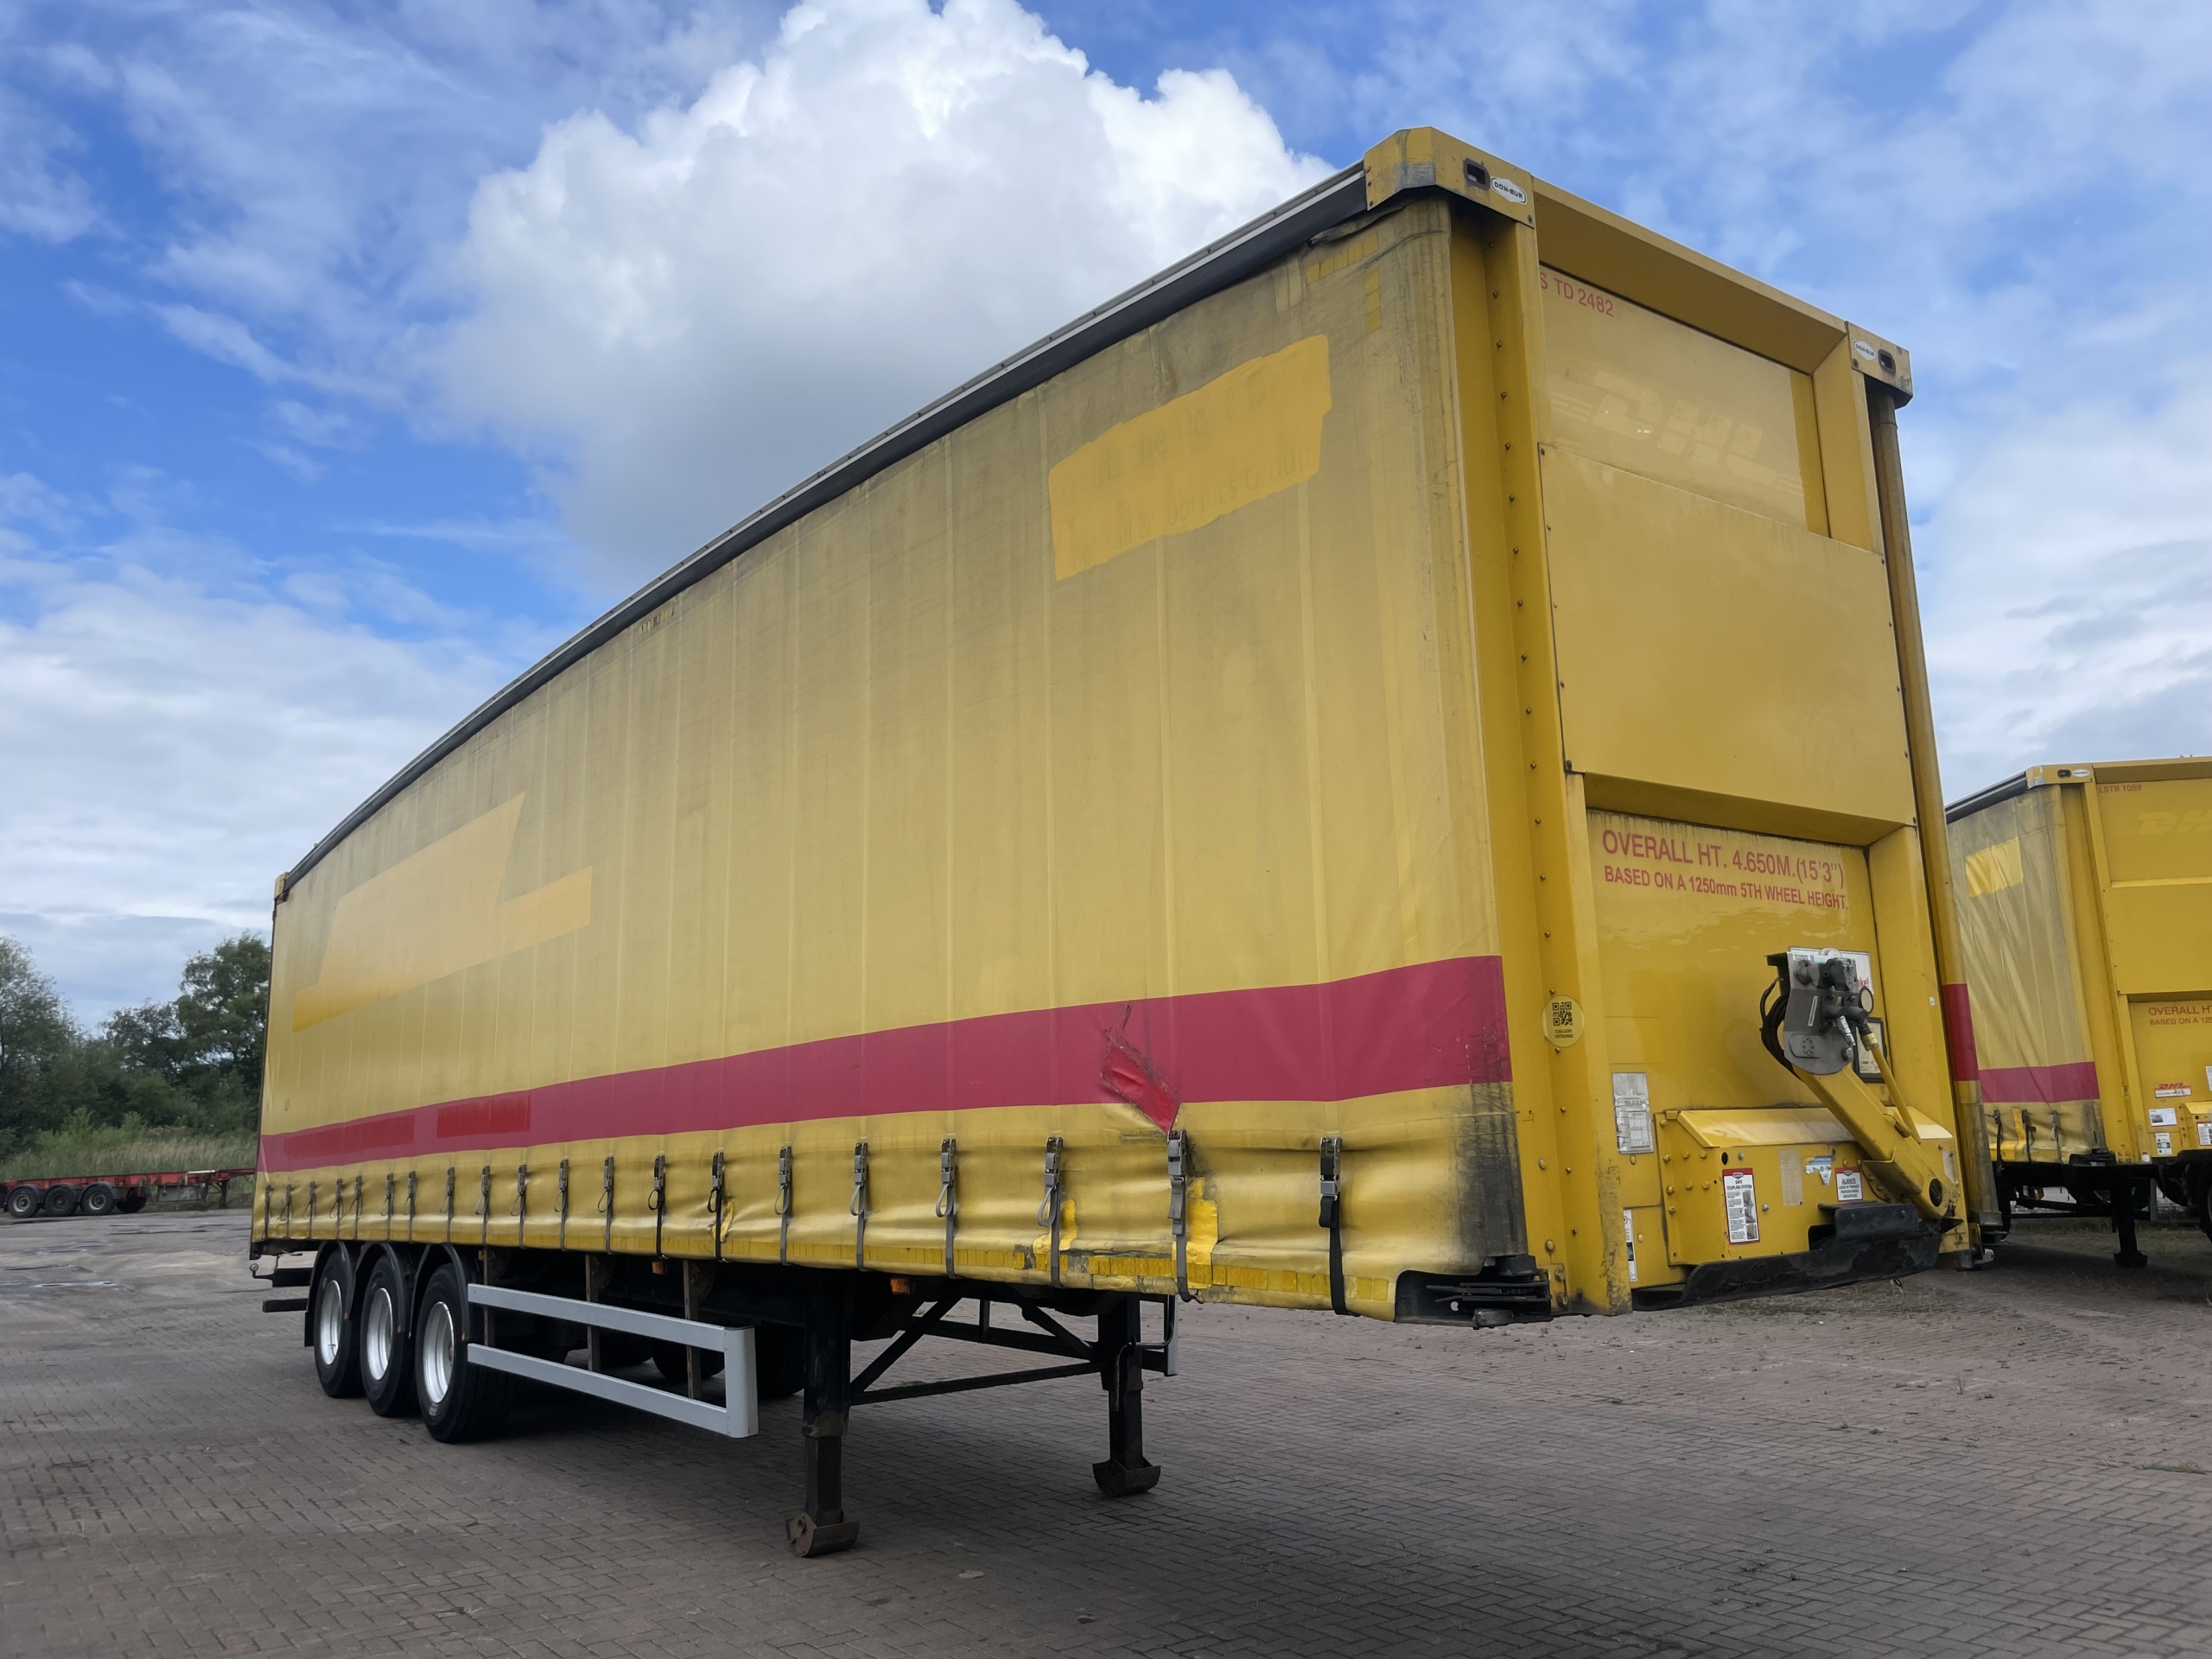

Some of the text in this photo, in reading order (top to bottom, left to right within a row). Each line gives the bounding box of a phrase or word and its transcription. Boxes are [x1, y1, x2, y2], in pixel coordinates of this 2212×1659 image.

[1494, 181, 1523, 200] DON-BUR
[1554, 277, 1573, 300] TD
[1578, 288, 1614, 317] 2482
[2123, 784, 2142, 792] 1059
[1603, 830, 1694, 864] OVERALL
[1698, 842, 1727, 868] HT.
[1605, 865, 1650, 887] BASED
[1654, 871, 1674, 889] ON
[1677, 874, 1687, 891] A
[1689, 875, 1738, 897] 1250mm
[1740, 882, 1763, 899] 5TH
[1764, 884, 1806, 905] WHEEL
[2148, 1006, 2200, 1015] OVERALL
